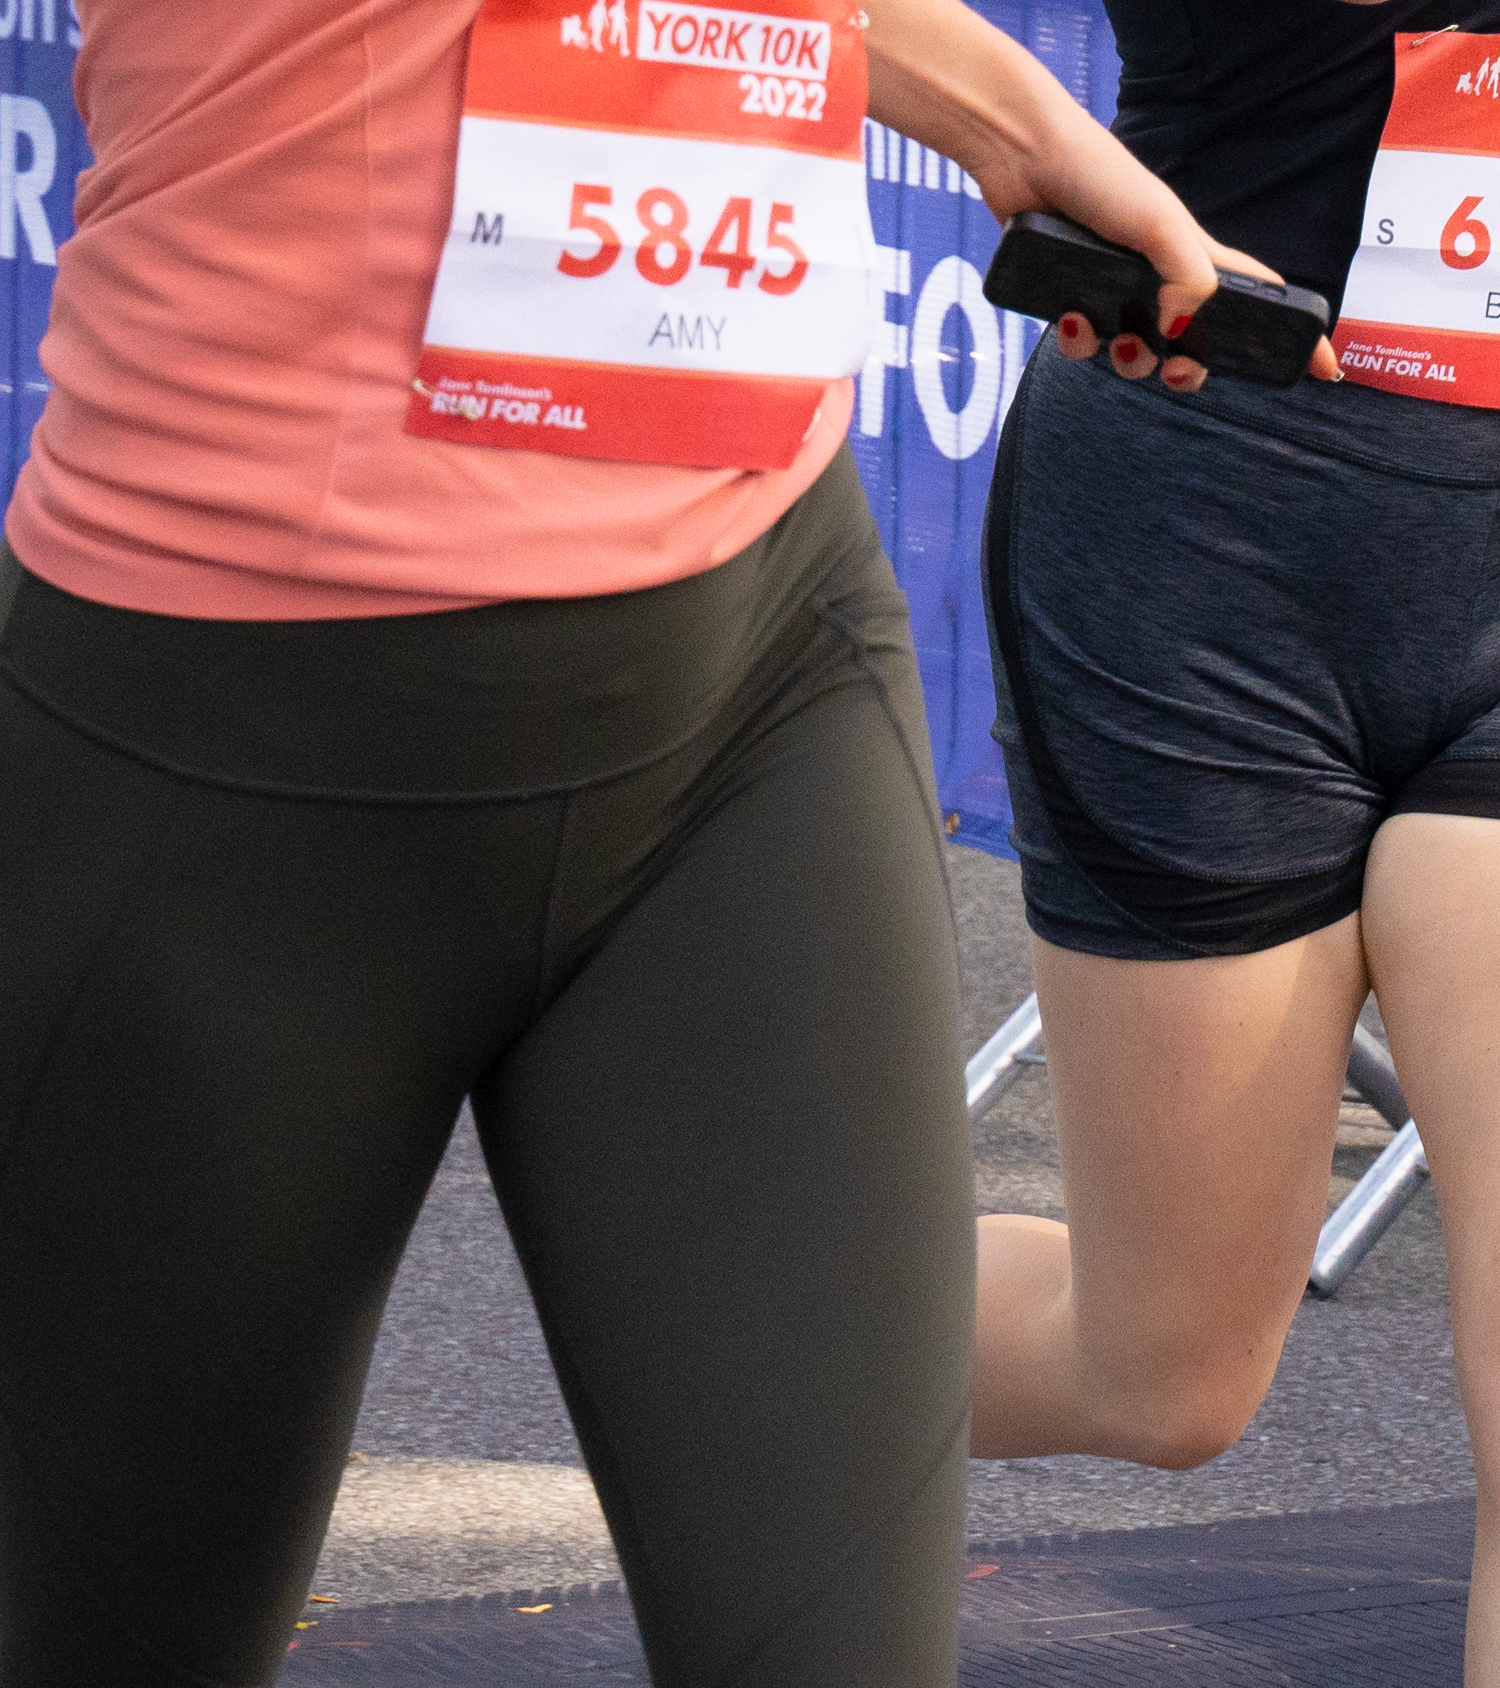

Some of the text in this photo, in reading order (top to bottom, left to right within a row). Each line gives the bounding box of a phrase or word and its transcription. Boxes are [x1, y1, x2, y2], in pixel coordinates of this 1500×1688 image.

[645, 10, 823, 70] YORK 10K
[738, 73, 827, 123] 2022
[470, 211, 504, 246] M
[556, 182, 810, 296] 5845
[1376, 218, 1395, 245] S
[647, 312, 728, 351] AMY
[1346, 340, 1432, 360] Jane Tomlinson's
[860, 244, 1049, 461] FO
[1340, 350, 1457, 382] RUN FOR ALL
[489, 398, 540, 424] FOR
[543, 404, 587, 429] ALL
